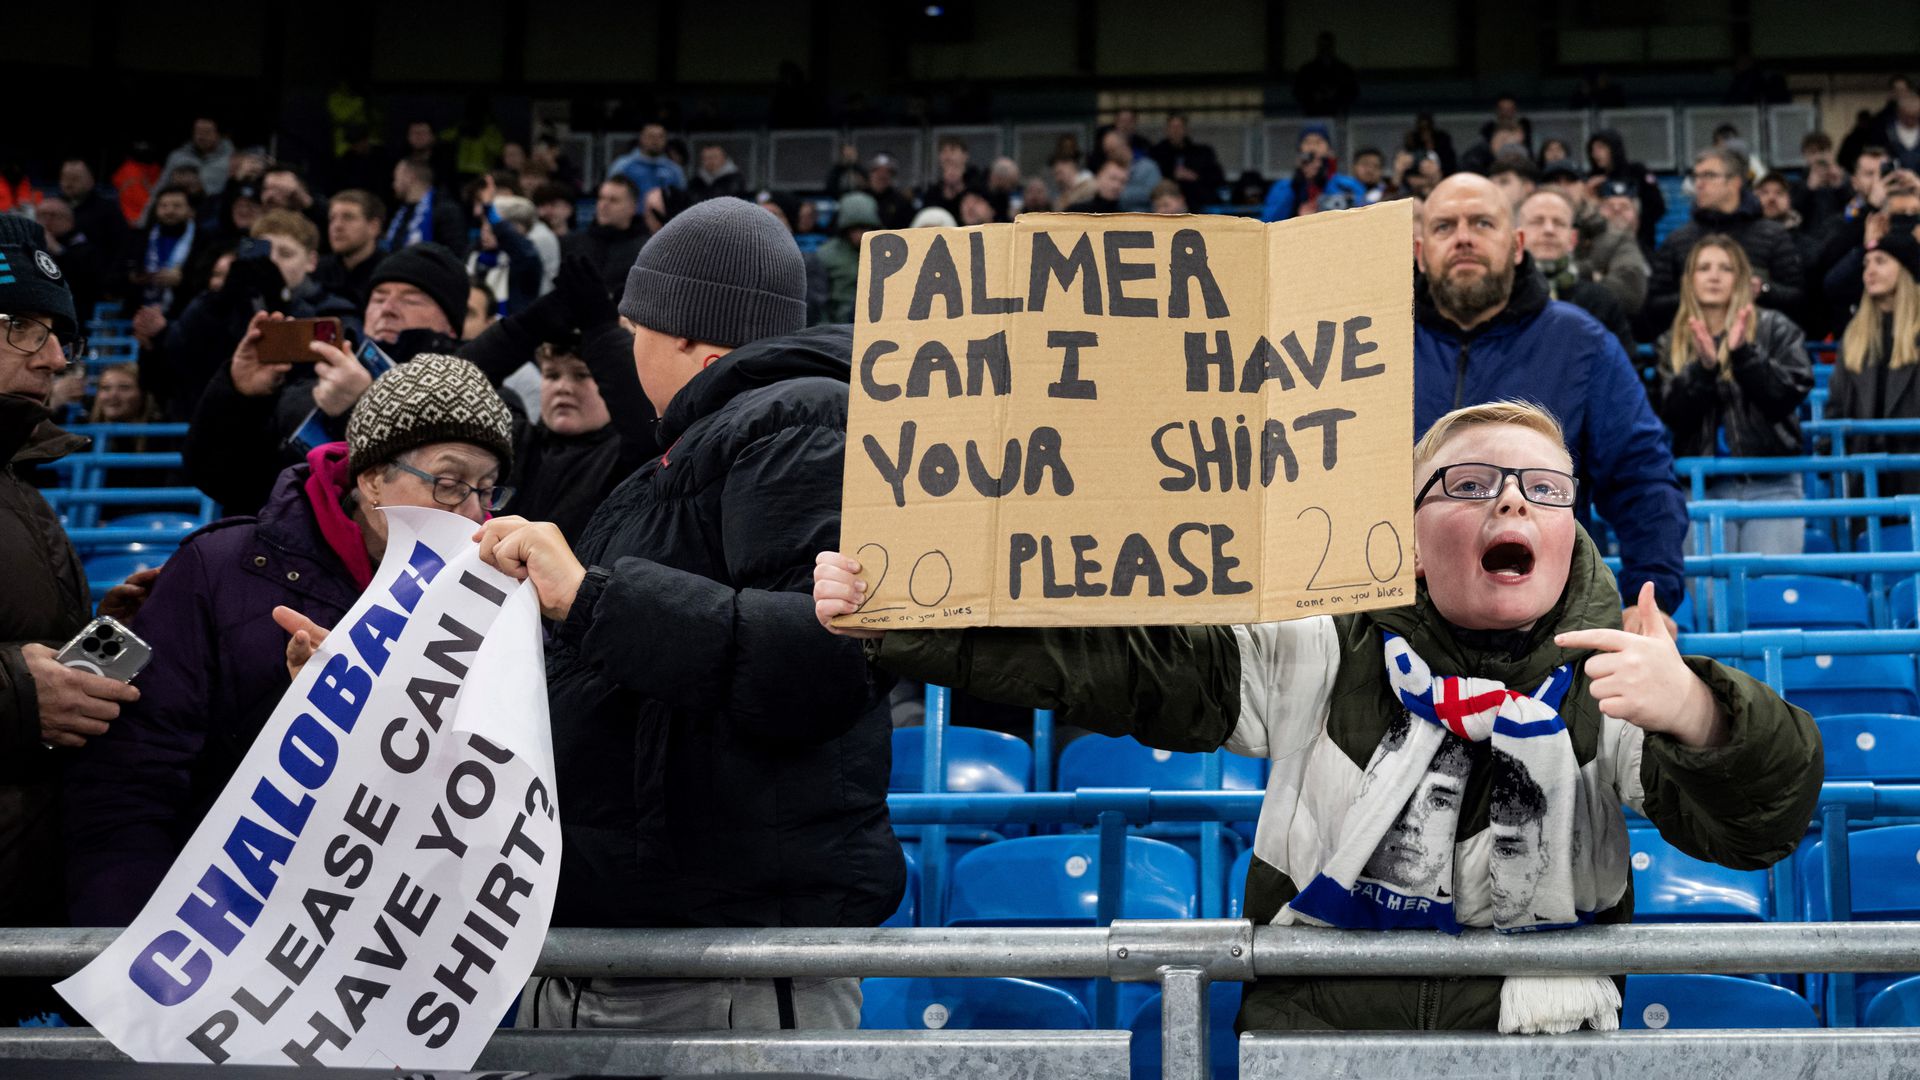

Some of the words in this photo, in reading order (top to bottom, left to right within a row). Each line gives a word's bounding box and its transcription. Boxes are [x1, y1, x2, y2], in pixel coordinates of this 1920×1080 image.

[868, 229, 1230, 323] PALMER
[859, 330, 1012, 402] CAN
[1047, 330, 1099, 400] I
[1184, 316, 1386, 394] HAVE
[862, 420, 1075, 508] YOUR
[857, 542, 953, 614] 20
[1009, 522, 1253, 600] PLEASE
[1297, 506, 1403, 591] 20
[917, 611, 936, 623] you
[943, 605, 973, 617] blues
[1331, 596, 1344, 604] on
[1350, 591, 1370, 605] you
[1377, 586, 1404, 598] blues
[185, 782, 400, 1065] PLEASE
[379, 612, 485, 775] CAN
[458, 570, 508, 608] I
[282, 872, 441, 1067] HAVE
[416, 733, 516, 858] YOU
[406, 775, 555, 1049] SHIRT?
[1350, 883, 1431, 913] PALMER
